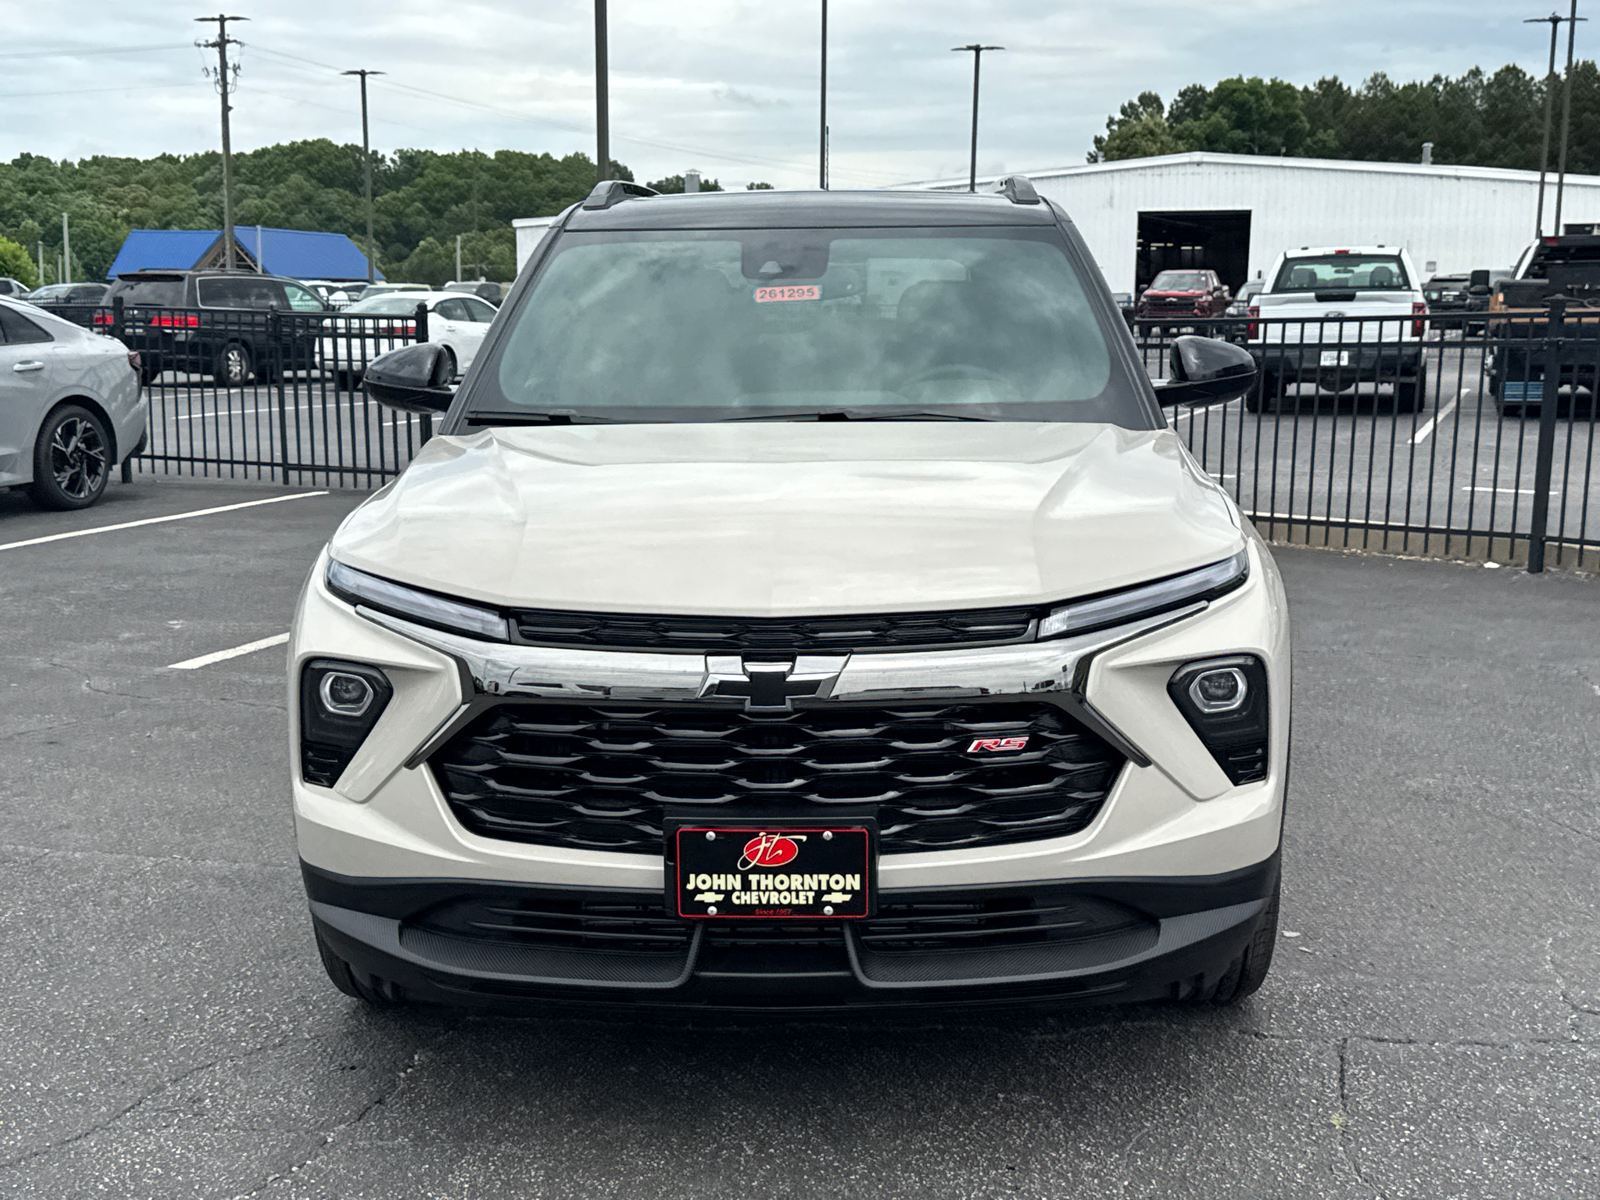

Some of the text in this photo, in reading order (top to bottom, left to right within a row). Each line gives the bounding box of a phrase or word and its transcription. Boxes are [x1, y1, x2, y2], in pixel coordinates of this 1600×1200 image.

[759, 287, 816, 299] 261295
[966, 736, 1030, 753] RS
[686, 874, 860, 890] JOHN THORNTON
[731, 891, 815, 904] CHEVROLET
